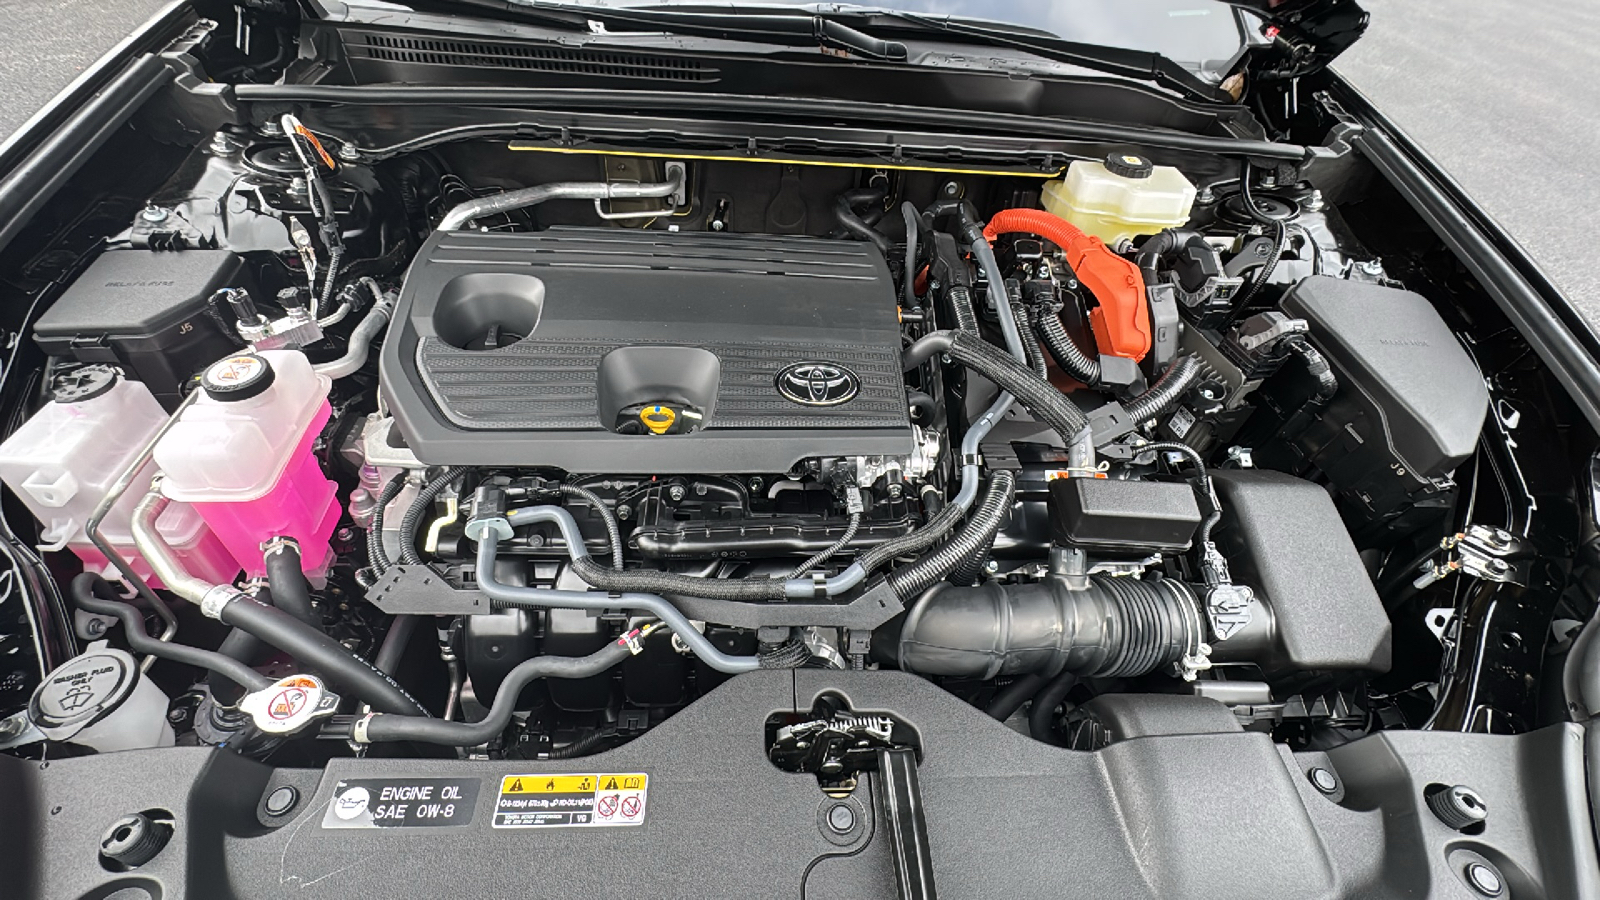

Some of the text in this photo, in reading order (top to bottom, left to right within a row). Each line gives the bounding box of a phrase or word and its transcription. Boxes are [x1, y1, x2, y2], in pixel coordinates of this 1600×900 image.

[180, 322, 193, 335] J5
[1390, 462, 1406, 476] J9
[53, 666, 114, 684] WASHER FLUID
[380, 786, 463, 801] ENGINE OIL
[374, 804, 409, 819] SAE
